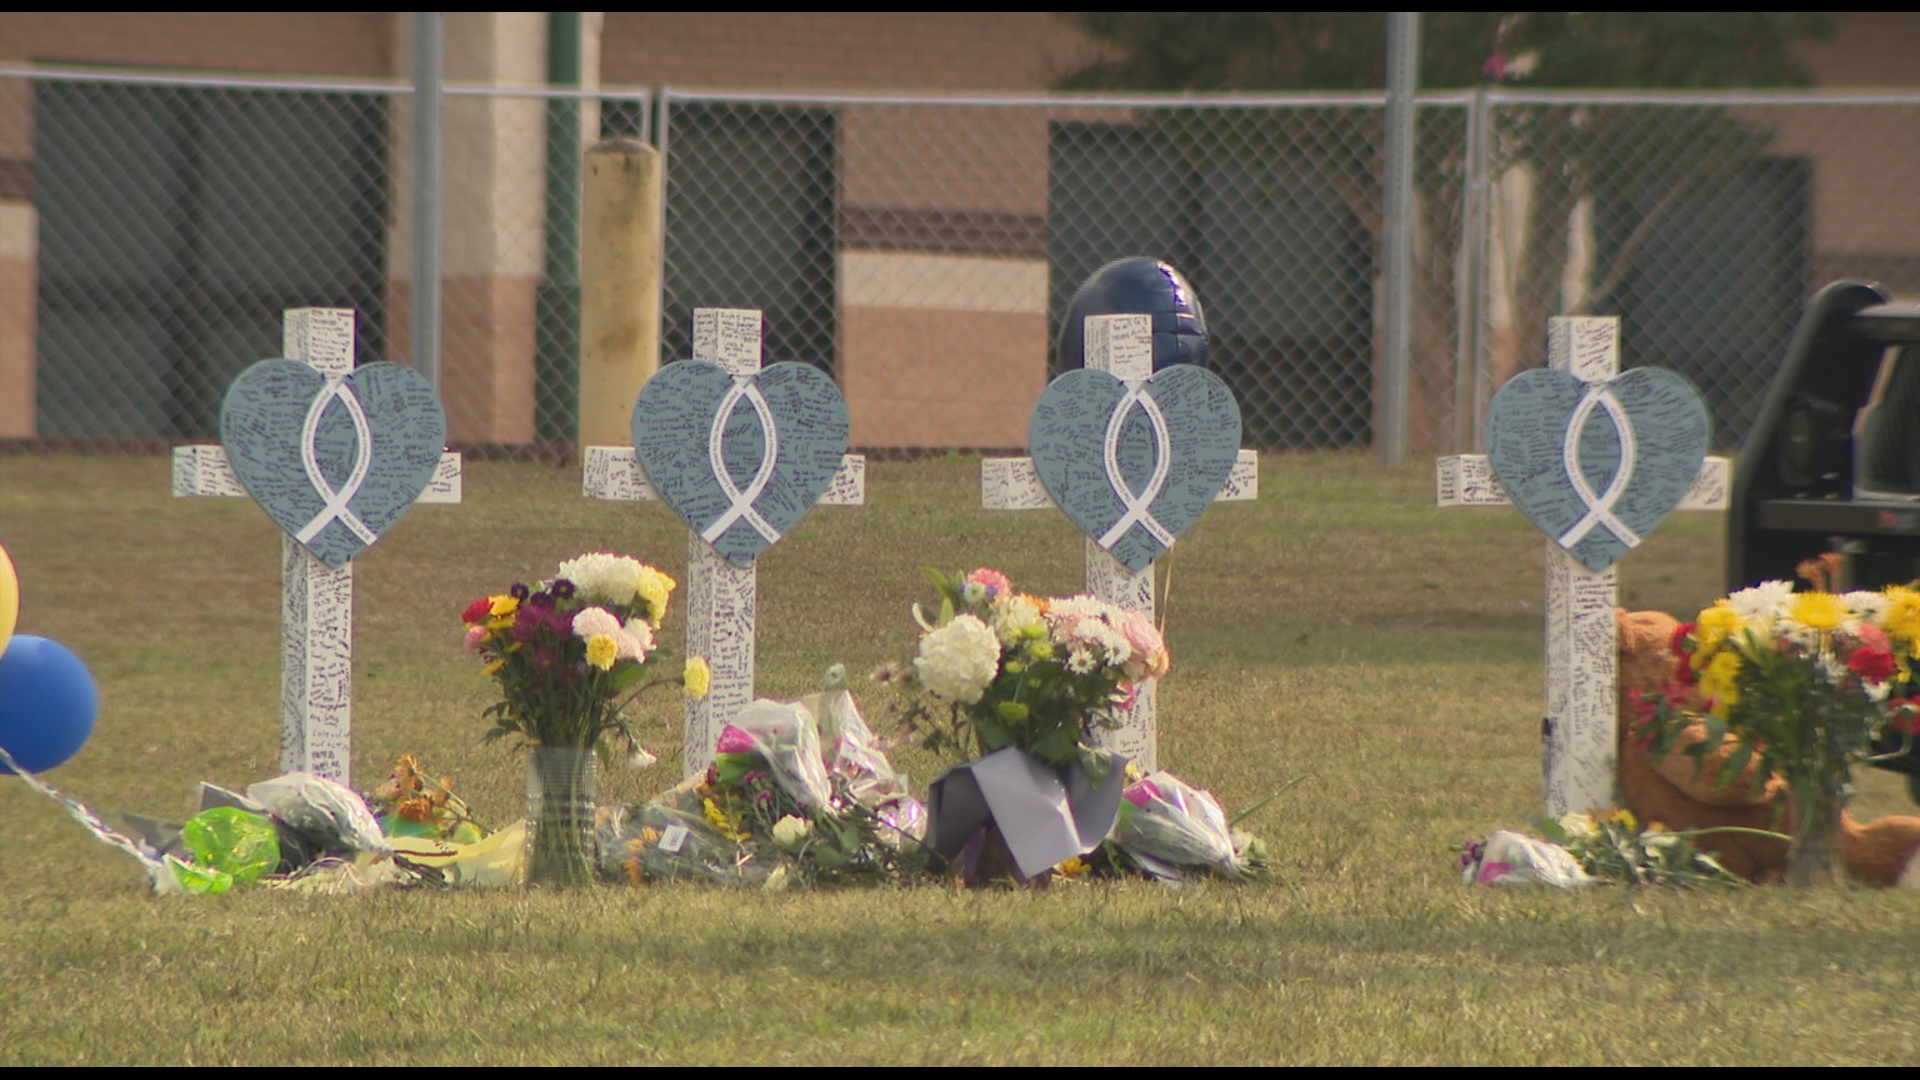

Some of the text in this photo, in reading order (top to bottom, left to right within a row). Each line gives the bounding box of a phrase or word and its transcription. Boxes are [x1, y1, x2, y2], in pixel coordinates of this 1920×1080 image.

[755, 399, 765, 411] and
[718, 472, 730, 487] Lord
[726, 485, 737, 497] The
